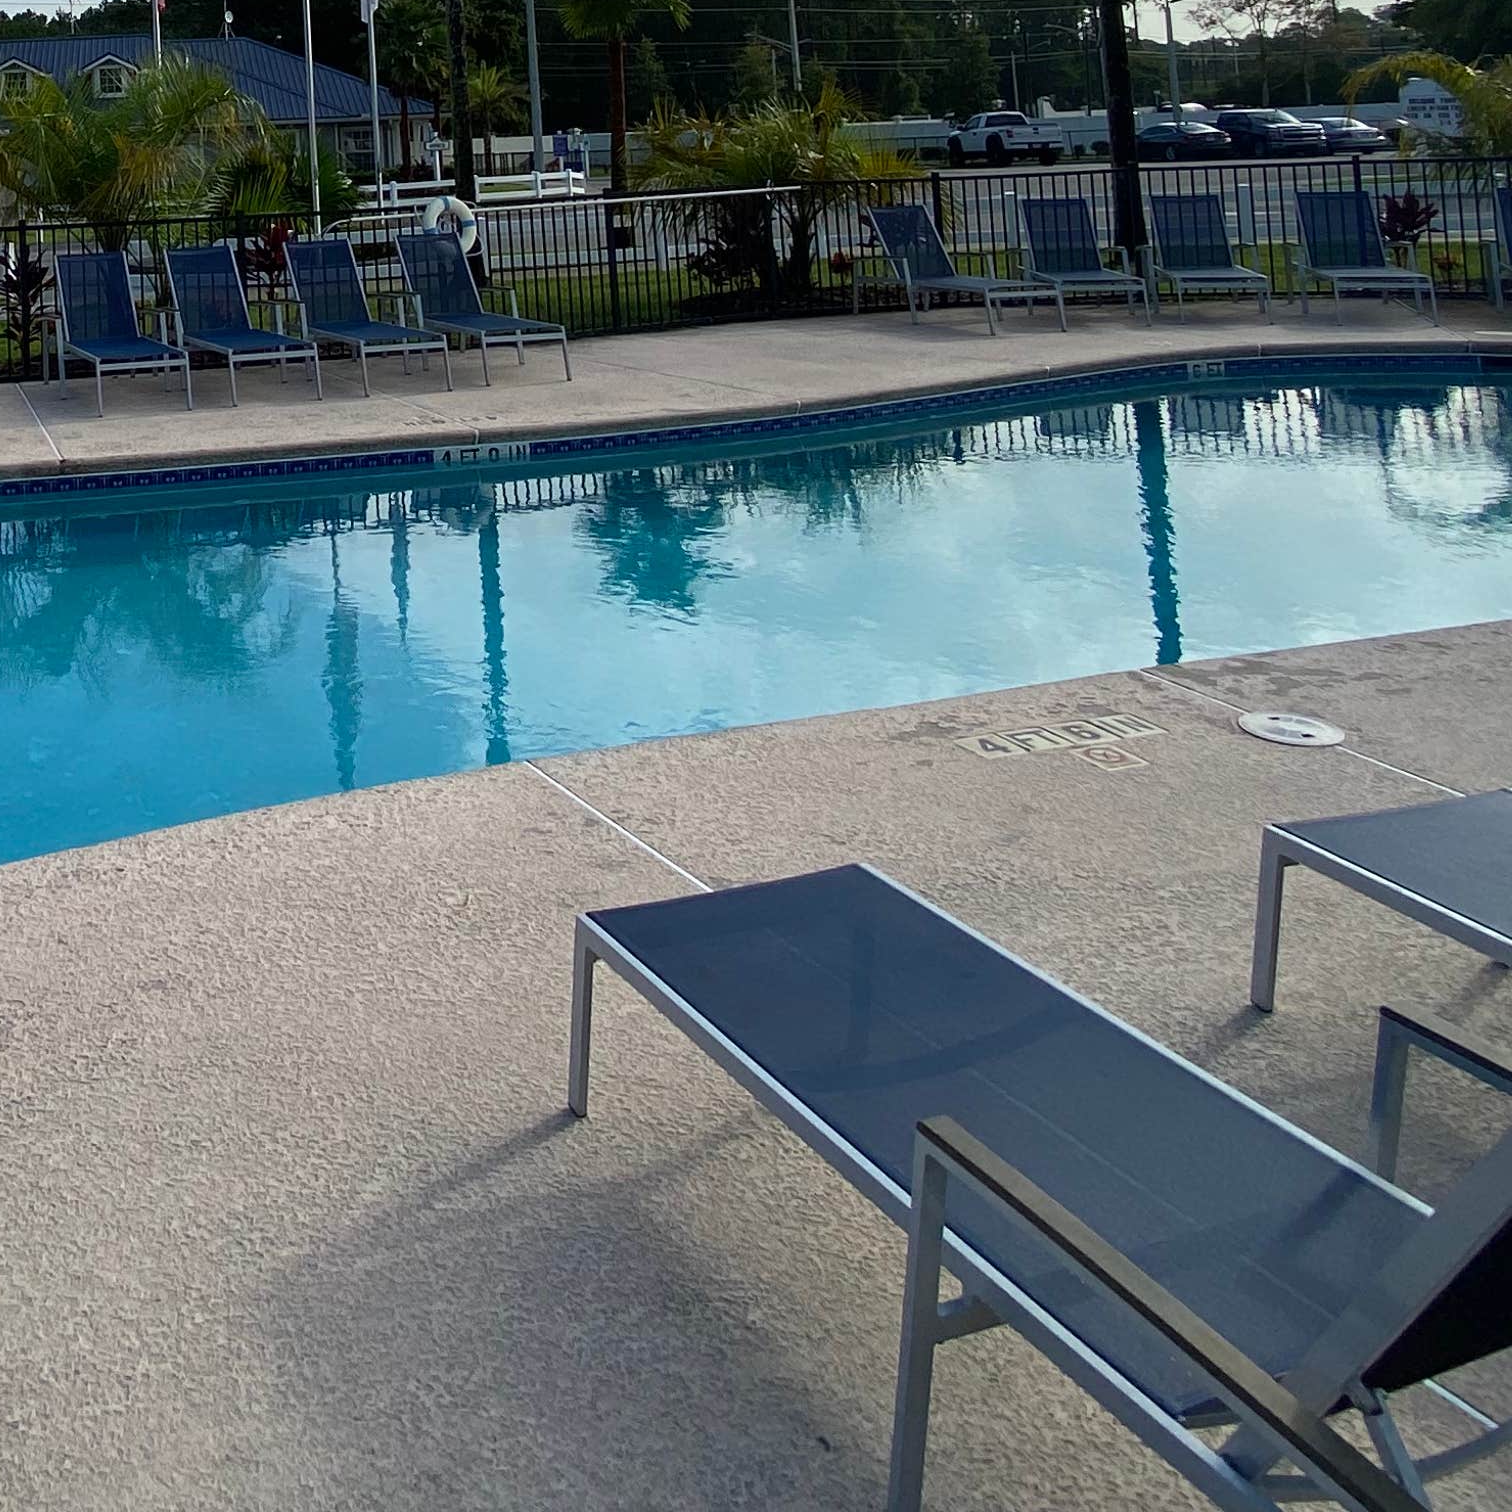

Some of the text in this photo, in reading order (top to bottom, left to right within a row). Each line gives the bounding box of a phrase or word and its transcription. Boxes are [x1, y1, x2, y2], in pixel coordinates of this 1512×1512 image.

[459, 447, 481, 463] FT
[508, 444, 527, 459] IN
[978, 738, 1012, 753] 4
[1004, 729, 1060, 749] FT
[1096, 716, 1155, 735] IN
